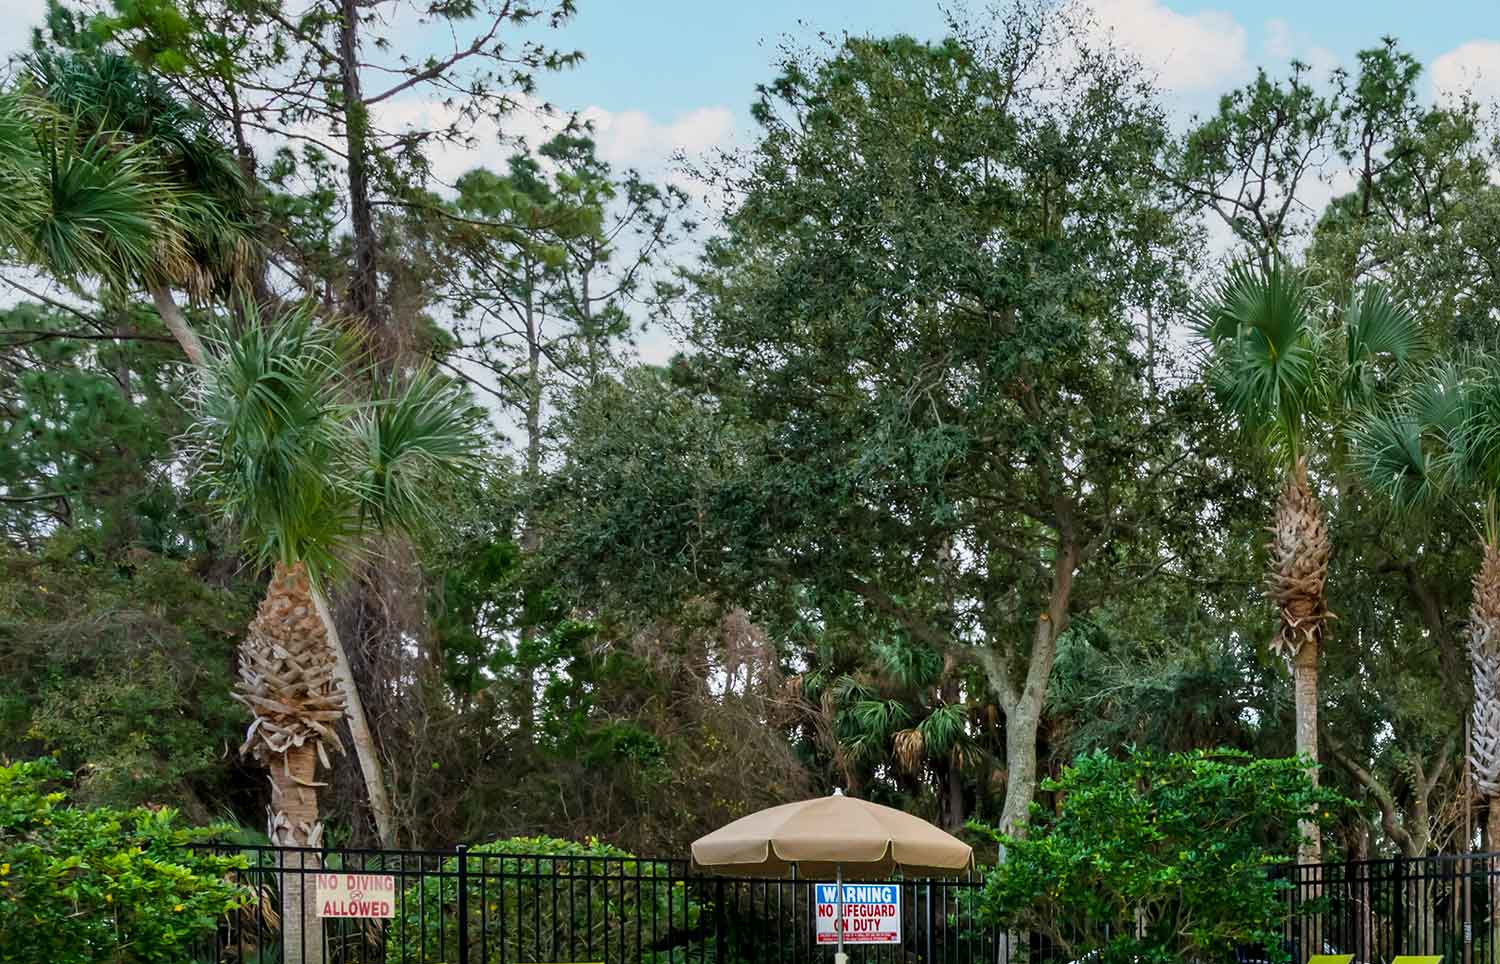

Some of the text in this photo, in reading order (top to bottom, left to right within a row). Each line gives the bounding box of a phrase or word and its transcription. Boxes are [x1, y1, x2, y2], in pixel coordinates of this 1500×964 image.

[318, 875, 393, 891] NO DIVING
[323, 901, 390, 916] ALLOWED
[818, 904, 834, 917] NO
[853, 919, 881, 931] DUTY
